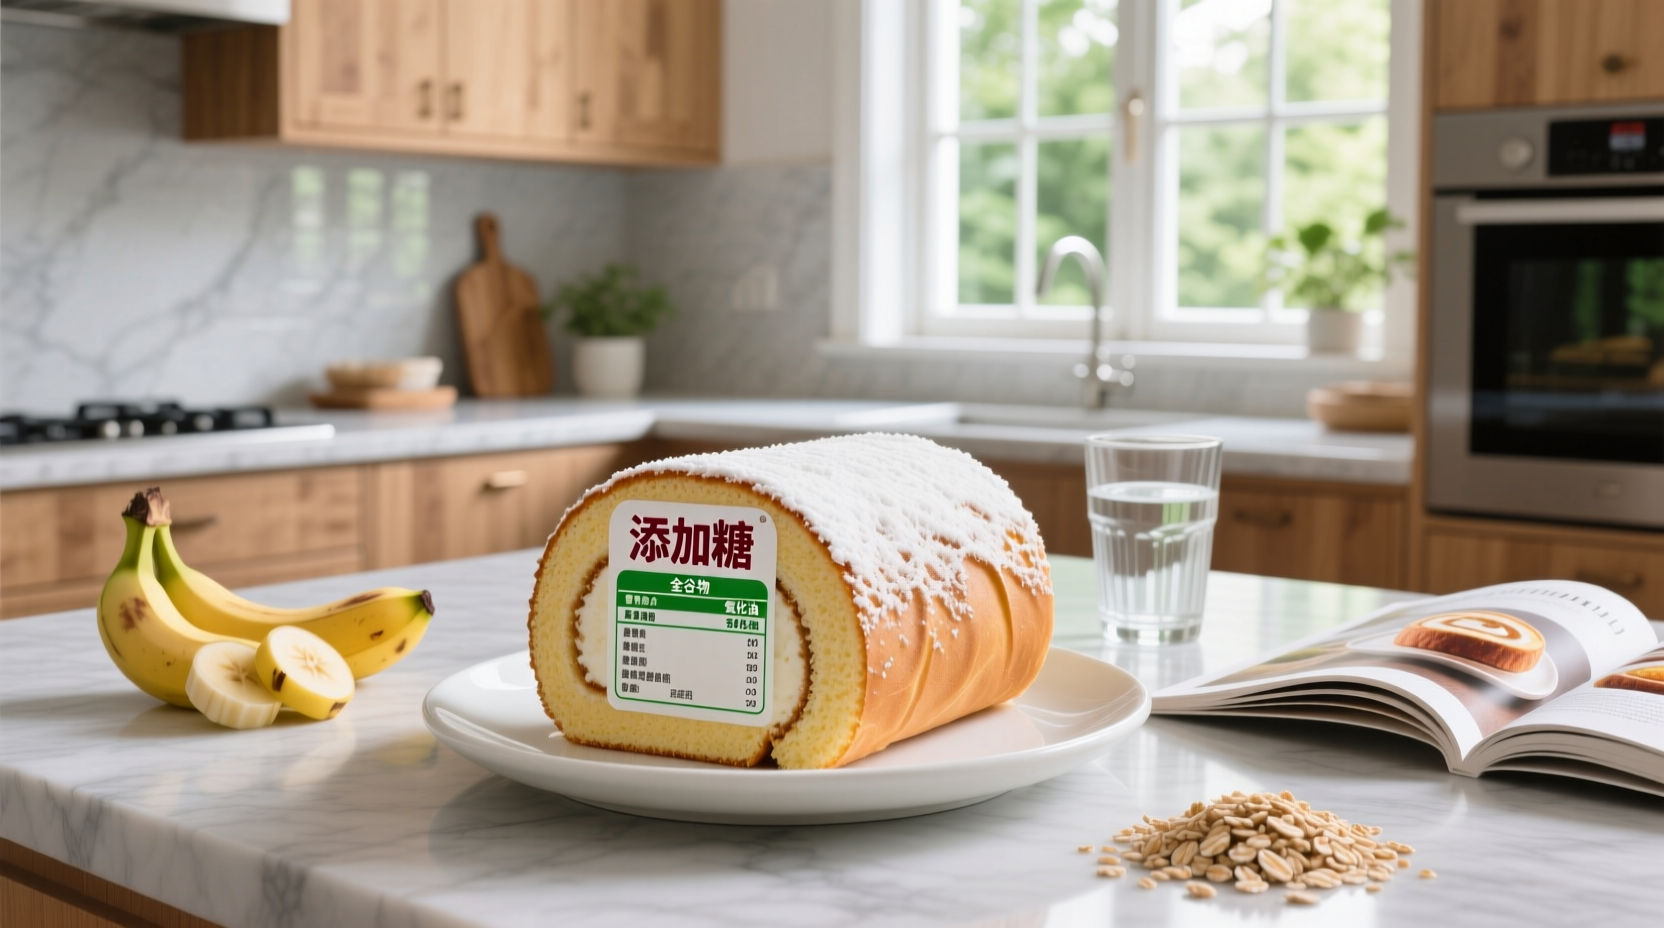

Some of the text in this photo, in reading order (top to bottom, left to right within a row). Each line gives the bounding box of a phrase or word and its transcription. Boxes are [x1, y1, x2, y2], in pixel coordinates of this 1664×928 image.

[629, 514, 754, 570] 添加糖
[670, 577, 710, 595] 全谷物
